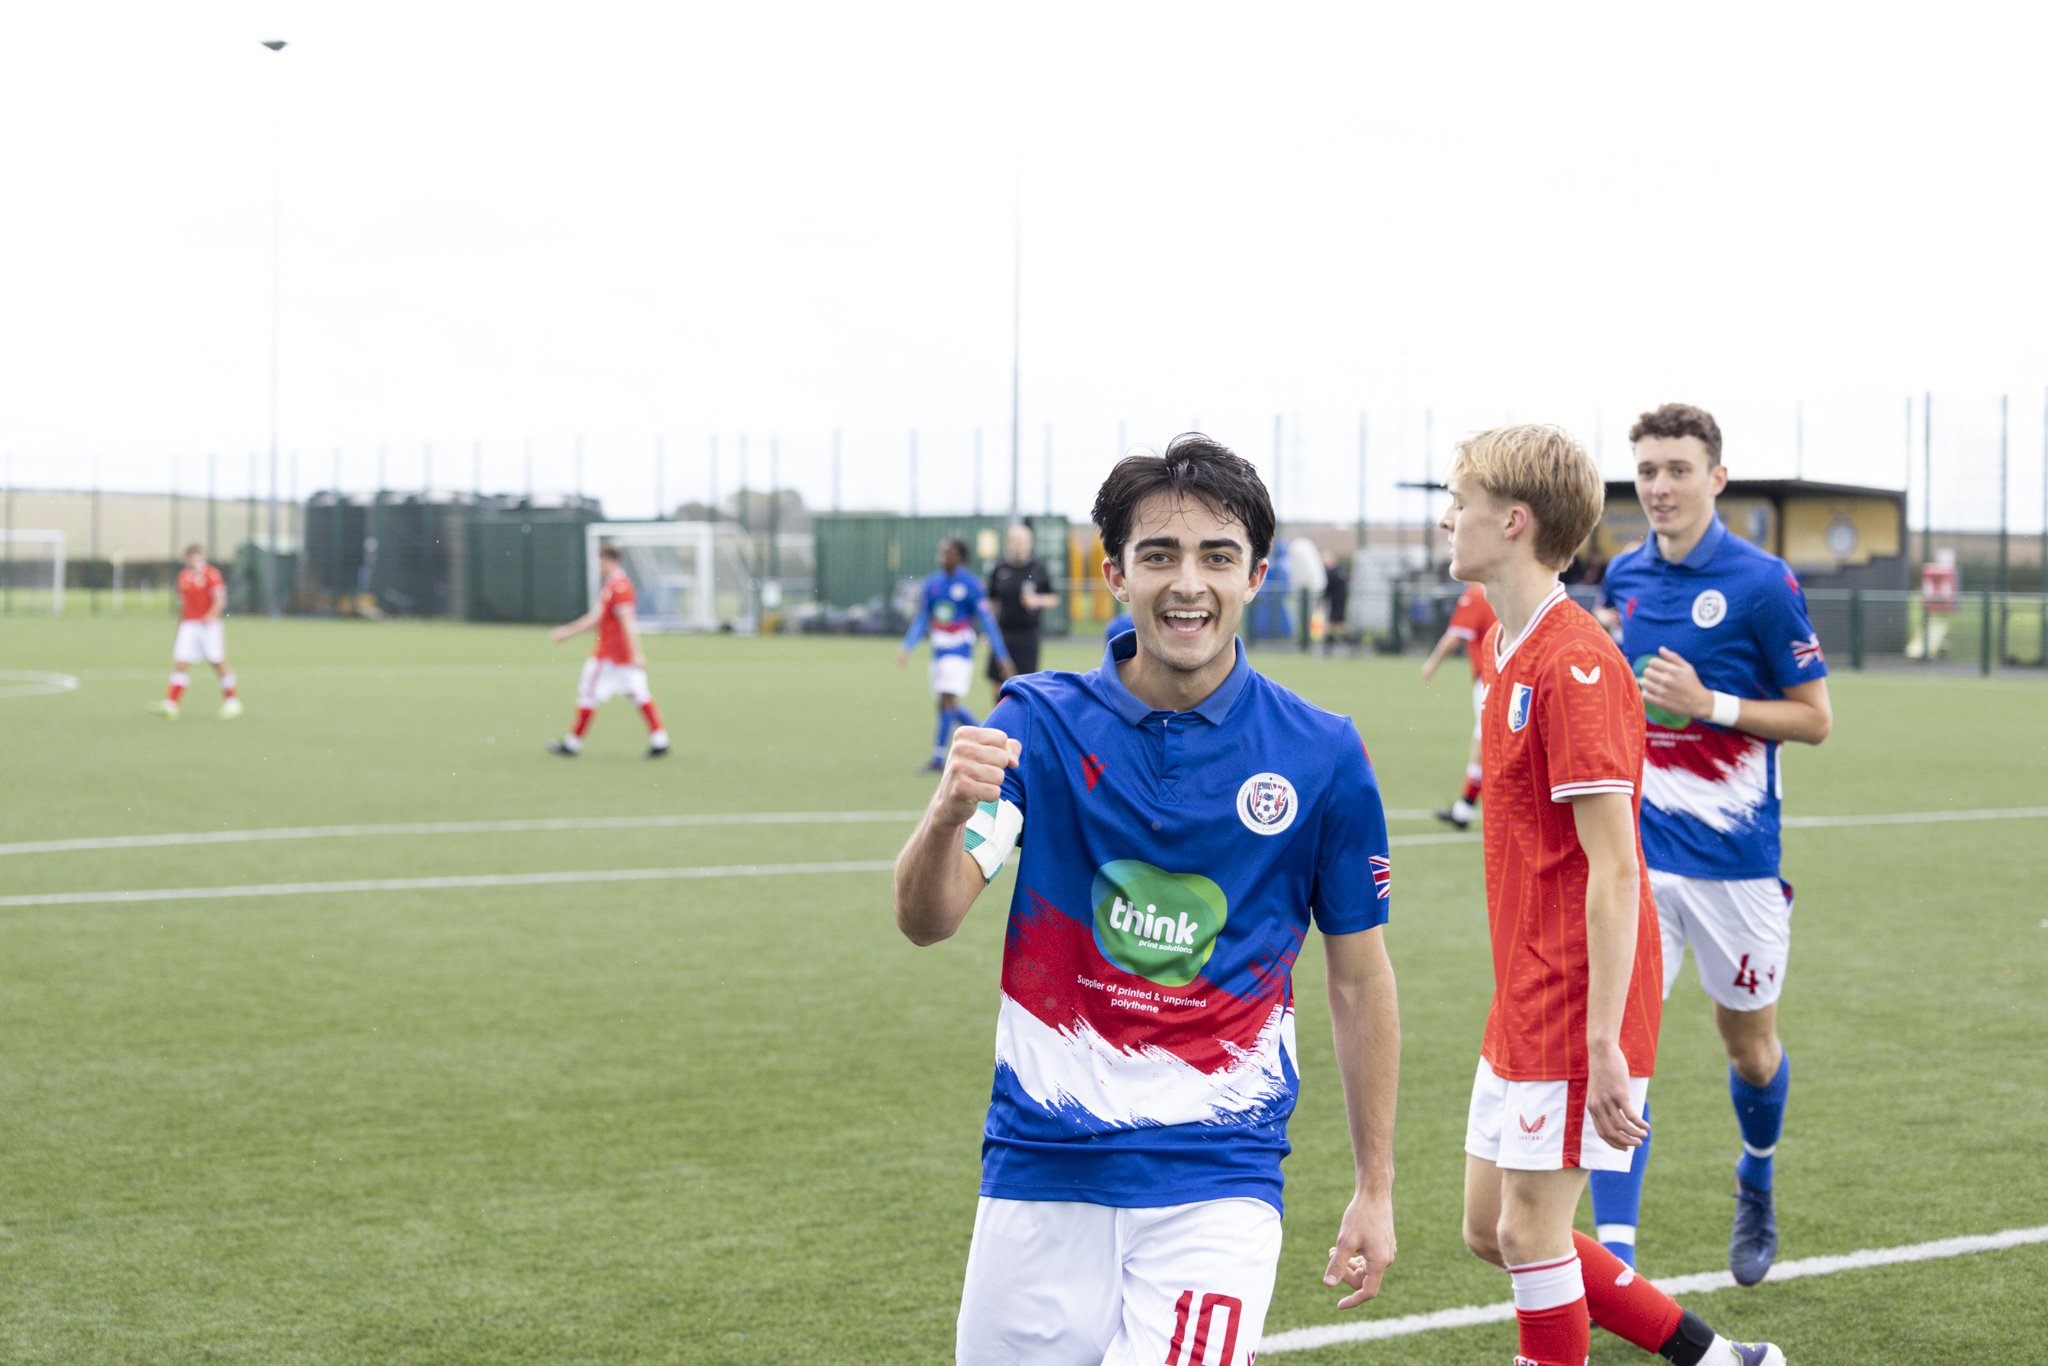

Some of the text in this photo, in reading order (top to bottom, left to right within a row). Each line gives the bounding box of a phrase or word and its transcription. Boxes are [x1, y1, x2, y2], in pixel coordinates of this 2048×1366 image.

[1110, 896, 1198, 945] think
[1138, 940, 1193, 954] print solutions
[1077, 974, 1207, 1008] Supplier of printed & unprinted
[1733, 953, 1759, 995] 4
[1111, 998, 1159, 1013] polythene
[1164, 1289, 1242, 1366] 10
